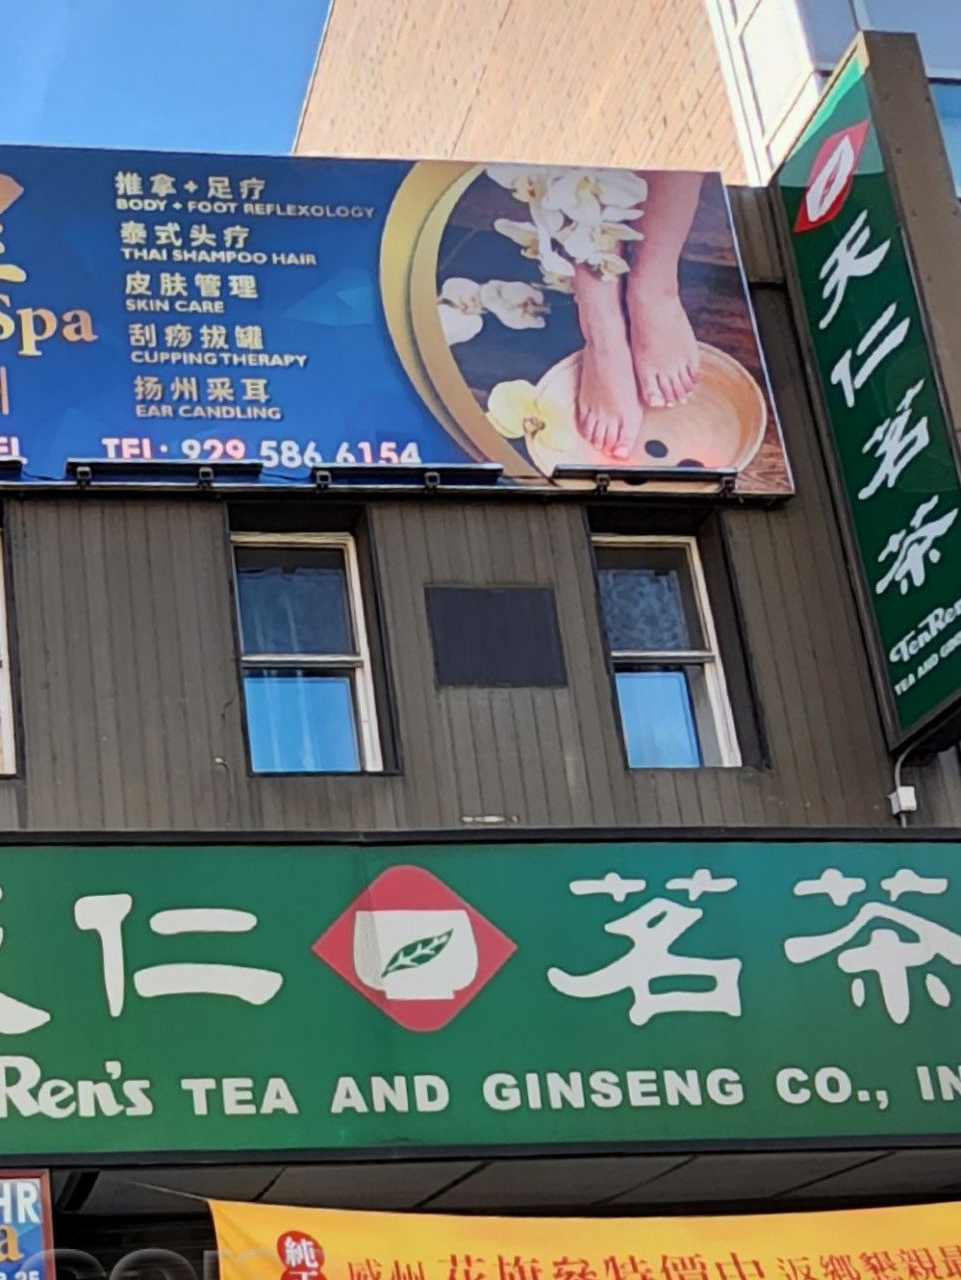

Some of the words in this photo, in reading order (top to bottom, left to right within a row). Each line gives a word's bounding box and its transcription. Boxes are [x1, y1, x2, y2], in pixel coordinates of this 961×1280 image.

[115, 198, 167, 212] BODY
[187, 200, 238, 214] FOOT
[243, 203, 375, 219] REFLEXOLOGY
[120, 220, 250, 249] 泰式头疗
[122, 248, 168, 262] THAI
[172, 249, 267, 265] SHAMPOO
[272, 253, 317, 266] HAIR
[125, 270, 258, 298] 皮肤管理
[125, 299, 170, 312] SKIN
[175, 301, 225, 314] CARE
[130, 351, 218, 365] CUPPING
[220, 353, 307, 368] THERAPY
[133, 375, 270, 403] 扬州采耳
[135, 404, 174, 418] EAR
[178, 405, 282, 420] CANDLING
[259, 440, 323, 468] 586
[180, 1077, 300, 1116] TEA
[330, 1076, 451, 1114] AND
[482, 1068, 745, 1110] GINSENG
[775, 1066, 889, 1110] CO.,
